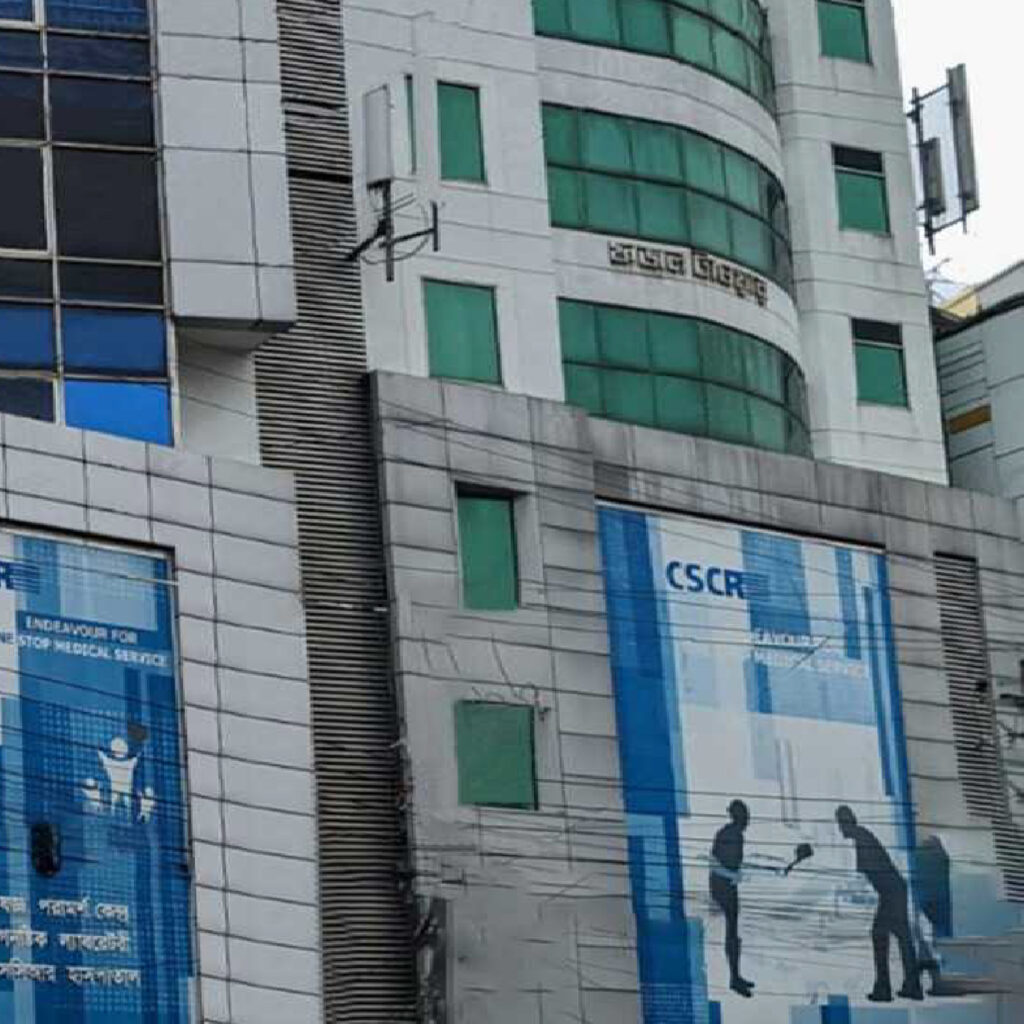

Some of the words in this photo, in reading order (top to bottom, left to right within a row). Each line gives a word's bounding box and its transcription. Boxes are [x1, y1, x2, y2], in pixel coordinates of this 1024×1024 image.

[665, 560, 747, 600] CSCR
[26, 615, 107, 640] ENDEAVOUR
[111, 628, 138, 644] FOR
[16, 634, 50, 649] STOP
[53, 639, 112, 659] MEDICAL
